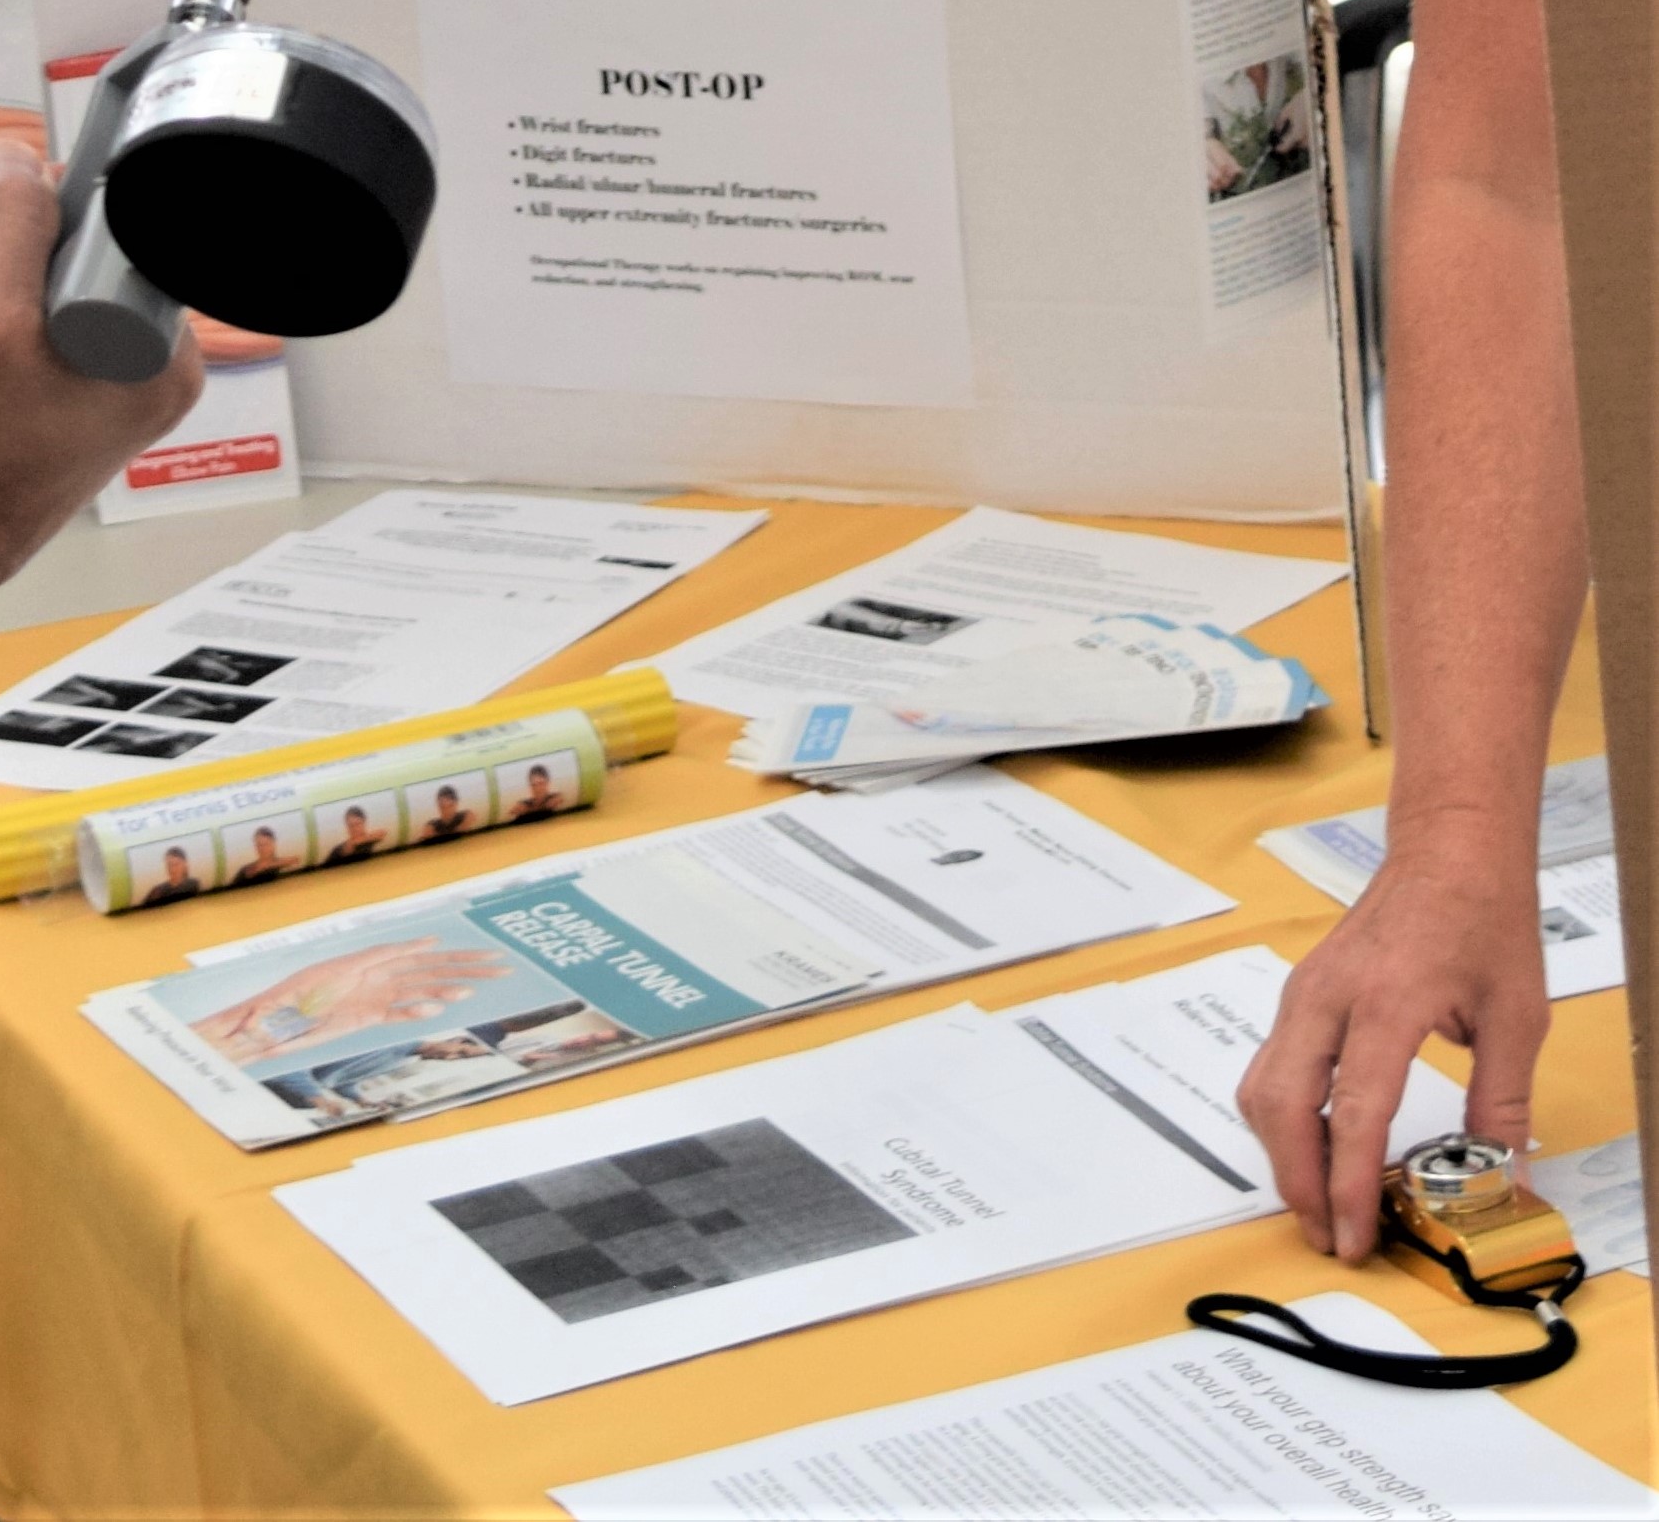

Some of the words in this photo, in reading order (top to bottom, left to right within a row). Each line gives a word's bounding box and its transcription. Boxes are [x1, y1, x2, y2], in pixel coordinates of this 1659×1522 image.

[599, 67, 766, 102] POST-OP
[520, 115, 571, 134] Wrist
[577, 118, 662, 139] fractures
[522, 144, 568, 165] Digit
[572, 146, 657, 166] fractures
[529, 200, 552, 217] All
[557, 206, 610, 225] upper
[614, 208, 701, 230] extremity
[731, 181, 819, 202] fractures
[117, 815, 151, 834] for
[154, 799, 228, 827] Tennis
[230, 782, 297, 811] Elbow
[489, 908, 595, 968] RELEASE
[530, 900, 625, 957] CARPAL
[605, 948, 708, 1011] TUNNEL
[879, 1167, 966, 1228] Syndrome
[882, 1136, 953, 1180] Cubital
[940, 1176, 1008, 1220] Tunnel
[1171, 1360, 1237, 1400] about
[1212, 1399, 1275, 1431] your
[1262, 1432, 1342, 1481] overall
[1323, 1477, 1397, 1522] health
[1214, 1344, 1273, 1387] What
[1250, 1384, 1313, 1419] your
[1294, 1419, 1348, 1449] grip
[1338, 1448, 1428, 1504] strength
